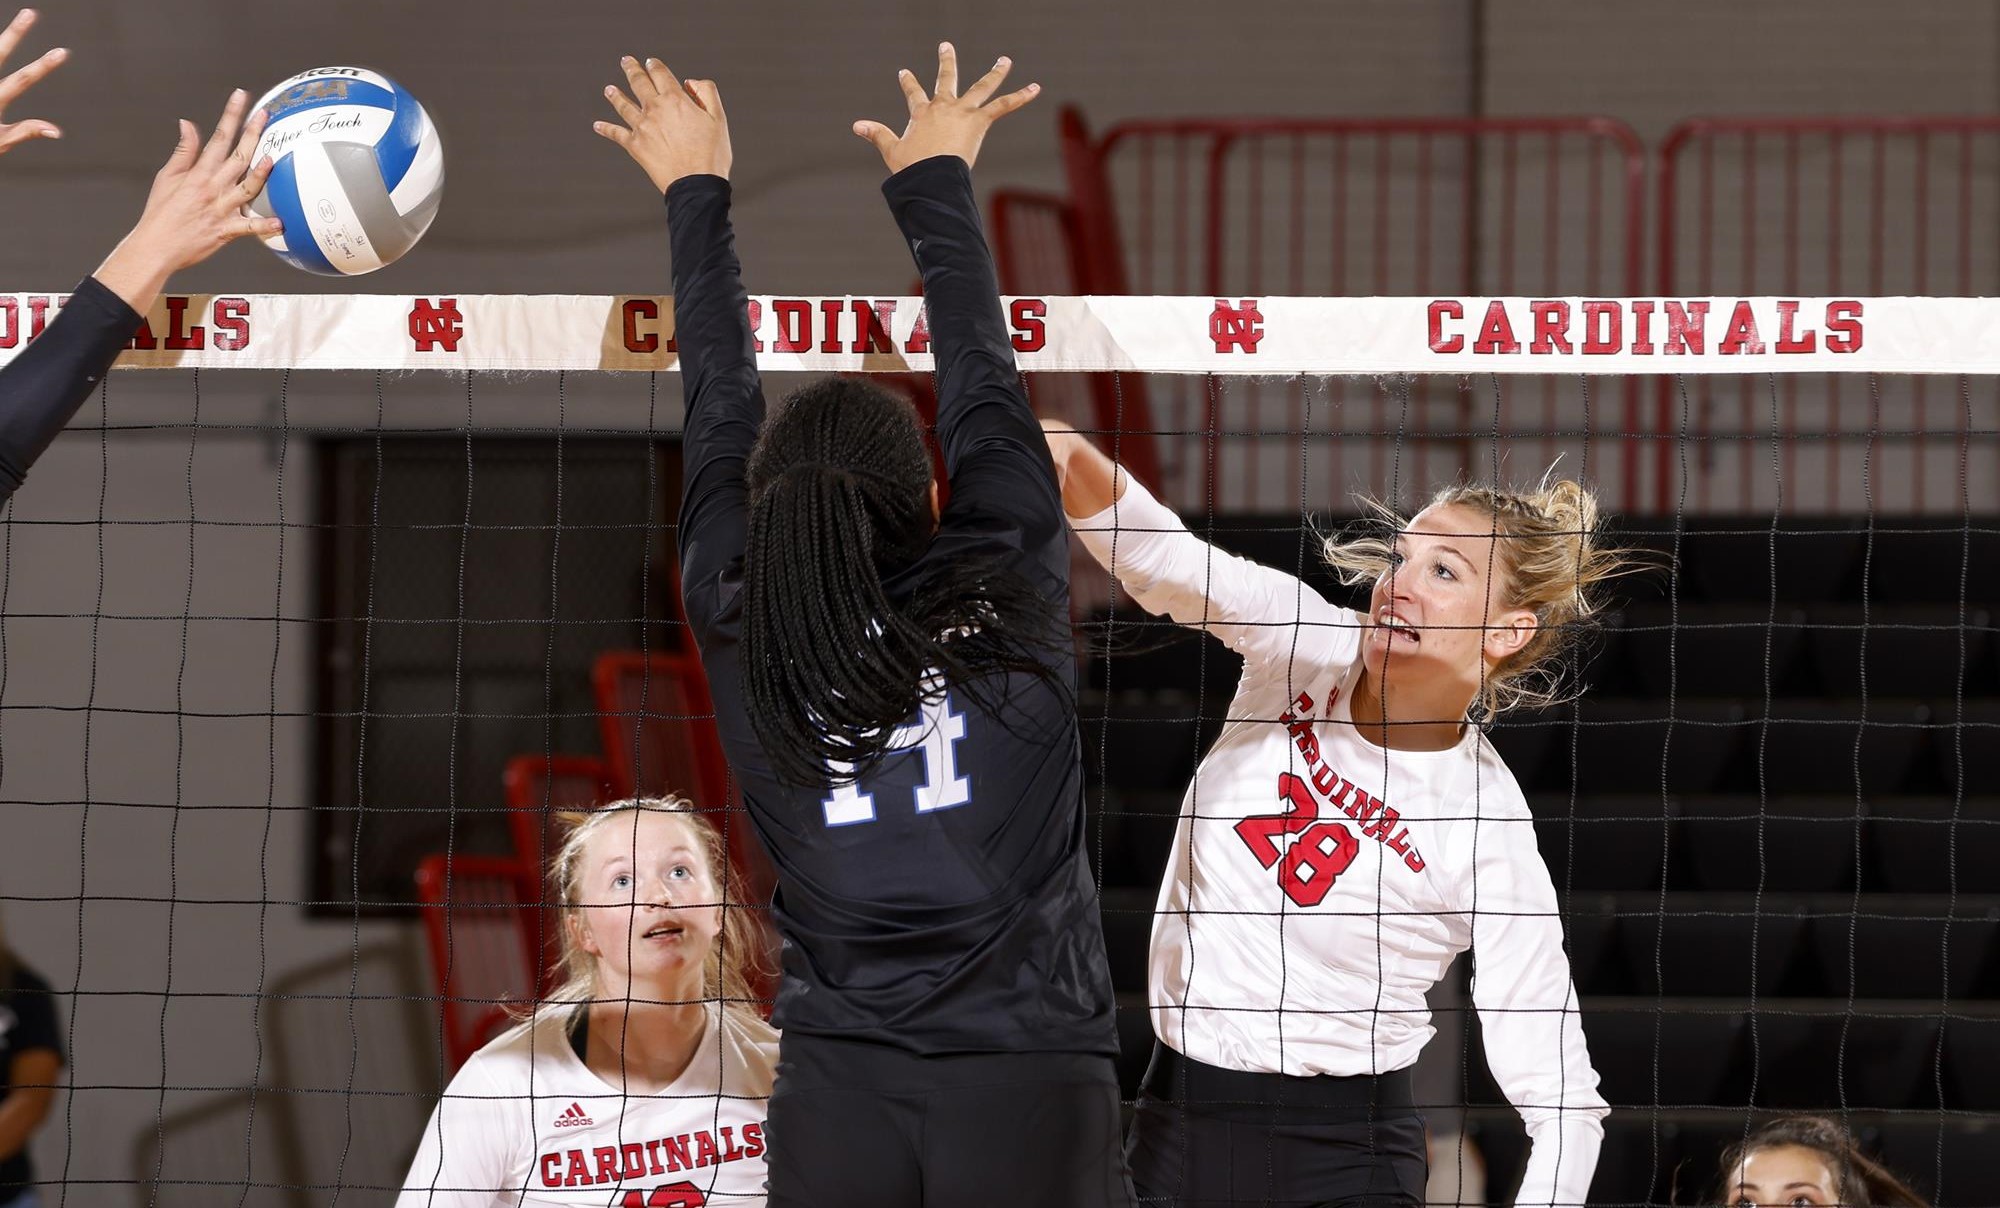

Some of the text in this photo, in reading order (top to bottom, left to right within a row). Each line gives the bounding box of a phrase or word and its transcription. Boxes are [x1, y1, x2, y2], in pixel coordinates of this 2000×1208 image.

[262, 112, 363, 155] Super Touch
[622, 299, 1047, 353] CDINAS
[1427, 299, 1864, 355] CARDINALS
[1232, 771, 1360, 908] 28
[553, 1115, 594, 1128] adidas
[540, 1121, 768, 1188] CARDINALS
